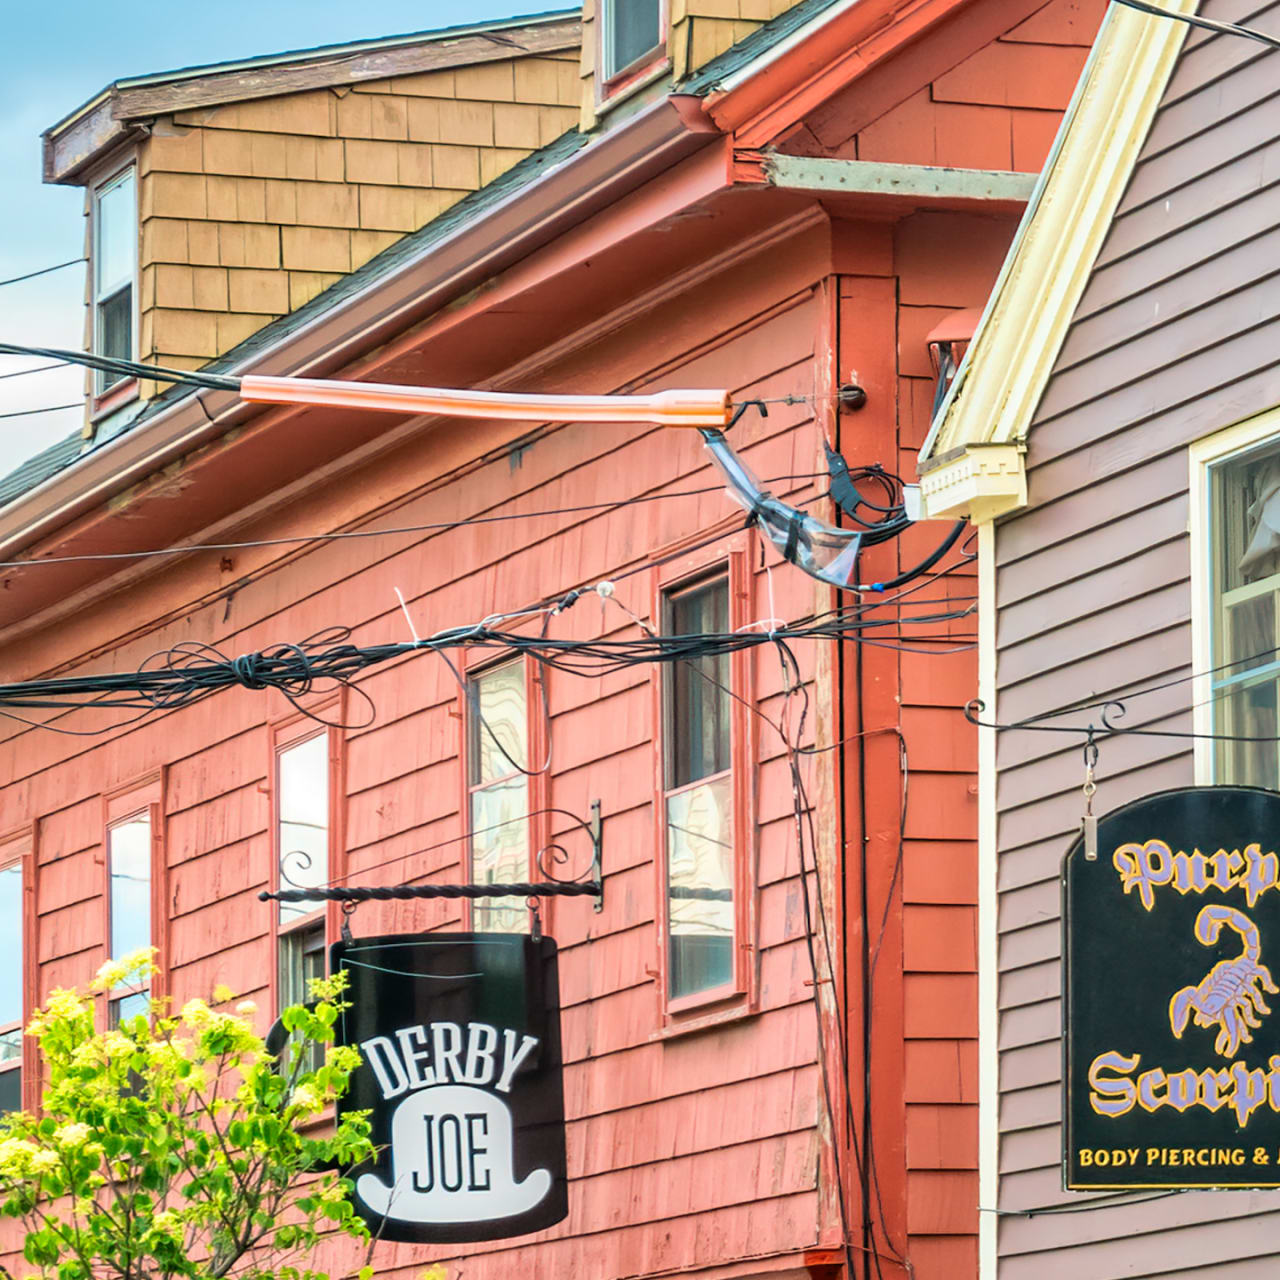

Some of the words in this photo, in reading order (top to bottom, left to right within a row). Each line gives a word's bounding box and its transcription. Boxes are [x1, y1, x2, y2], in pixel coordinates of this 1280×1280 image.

[361, 1022, 539, 1099] DERBY
[412, 1112, 490, 1194] JOE
[1079, 1148, 1139, 1167] BODY
[1146, 1148, 1246, 1166] PIERCING
[1252, 1148, 1269, 1164] &
